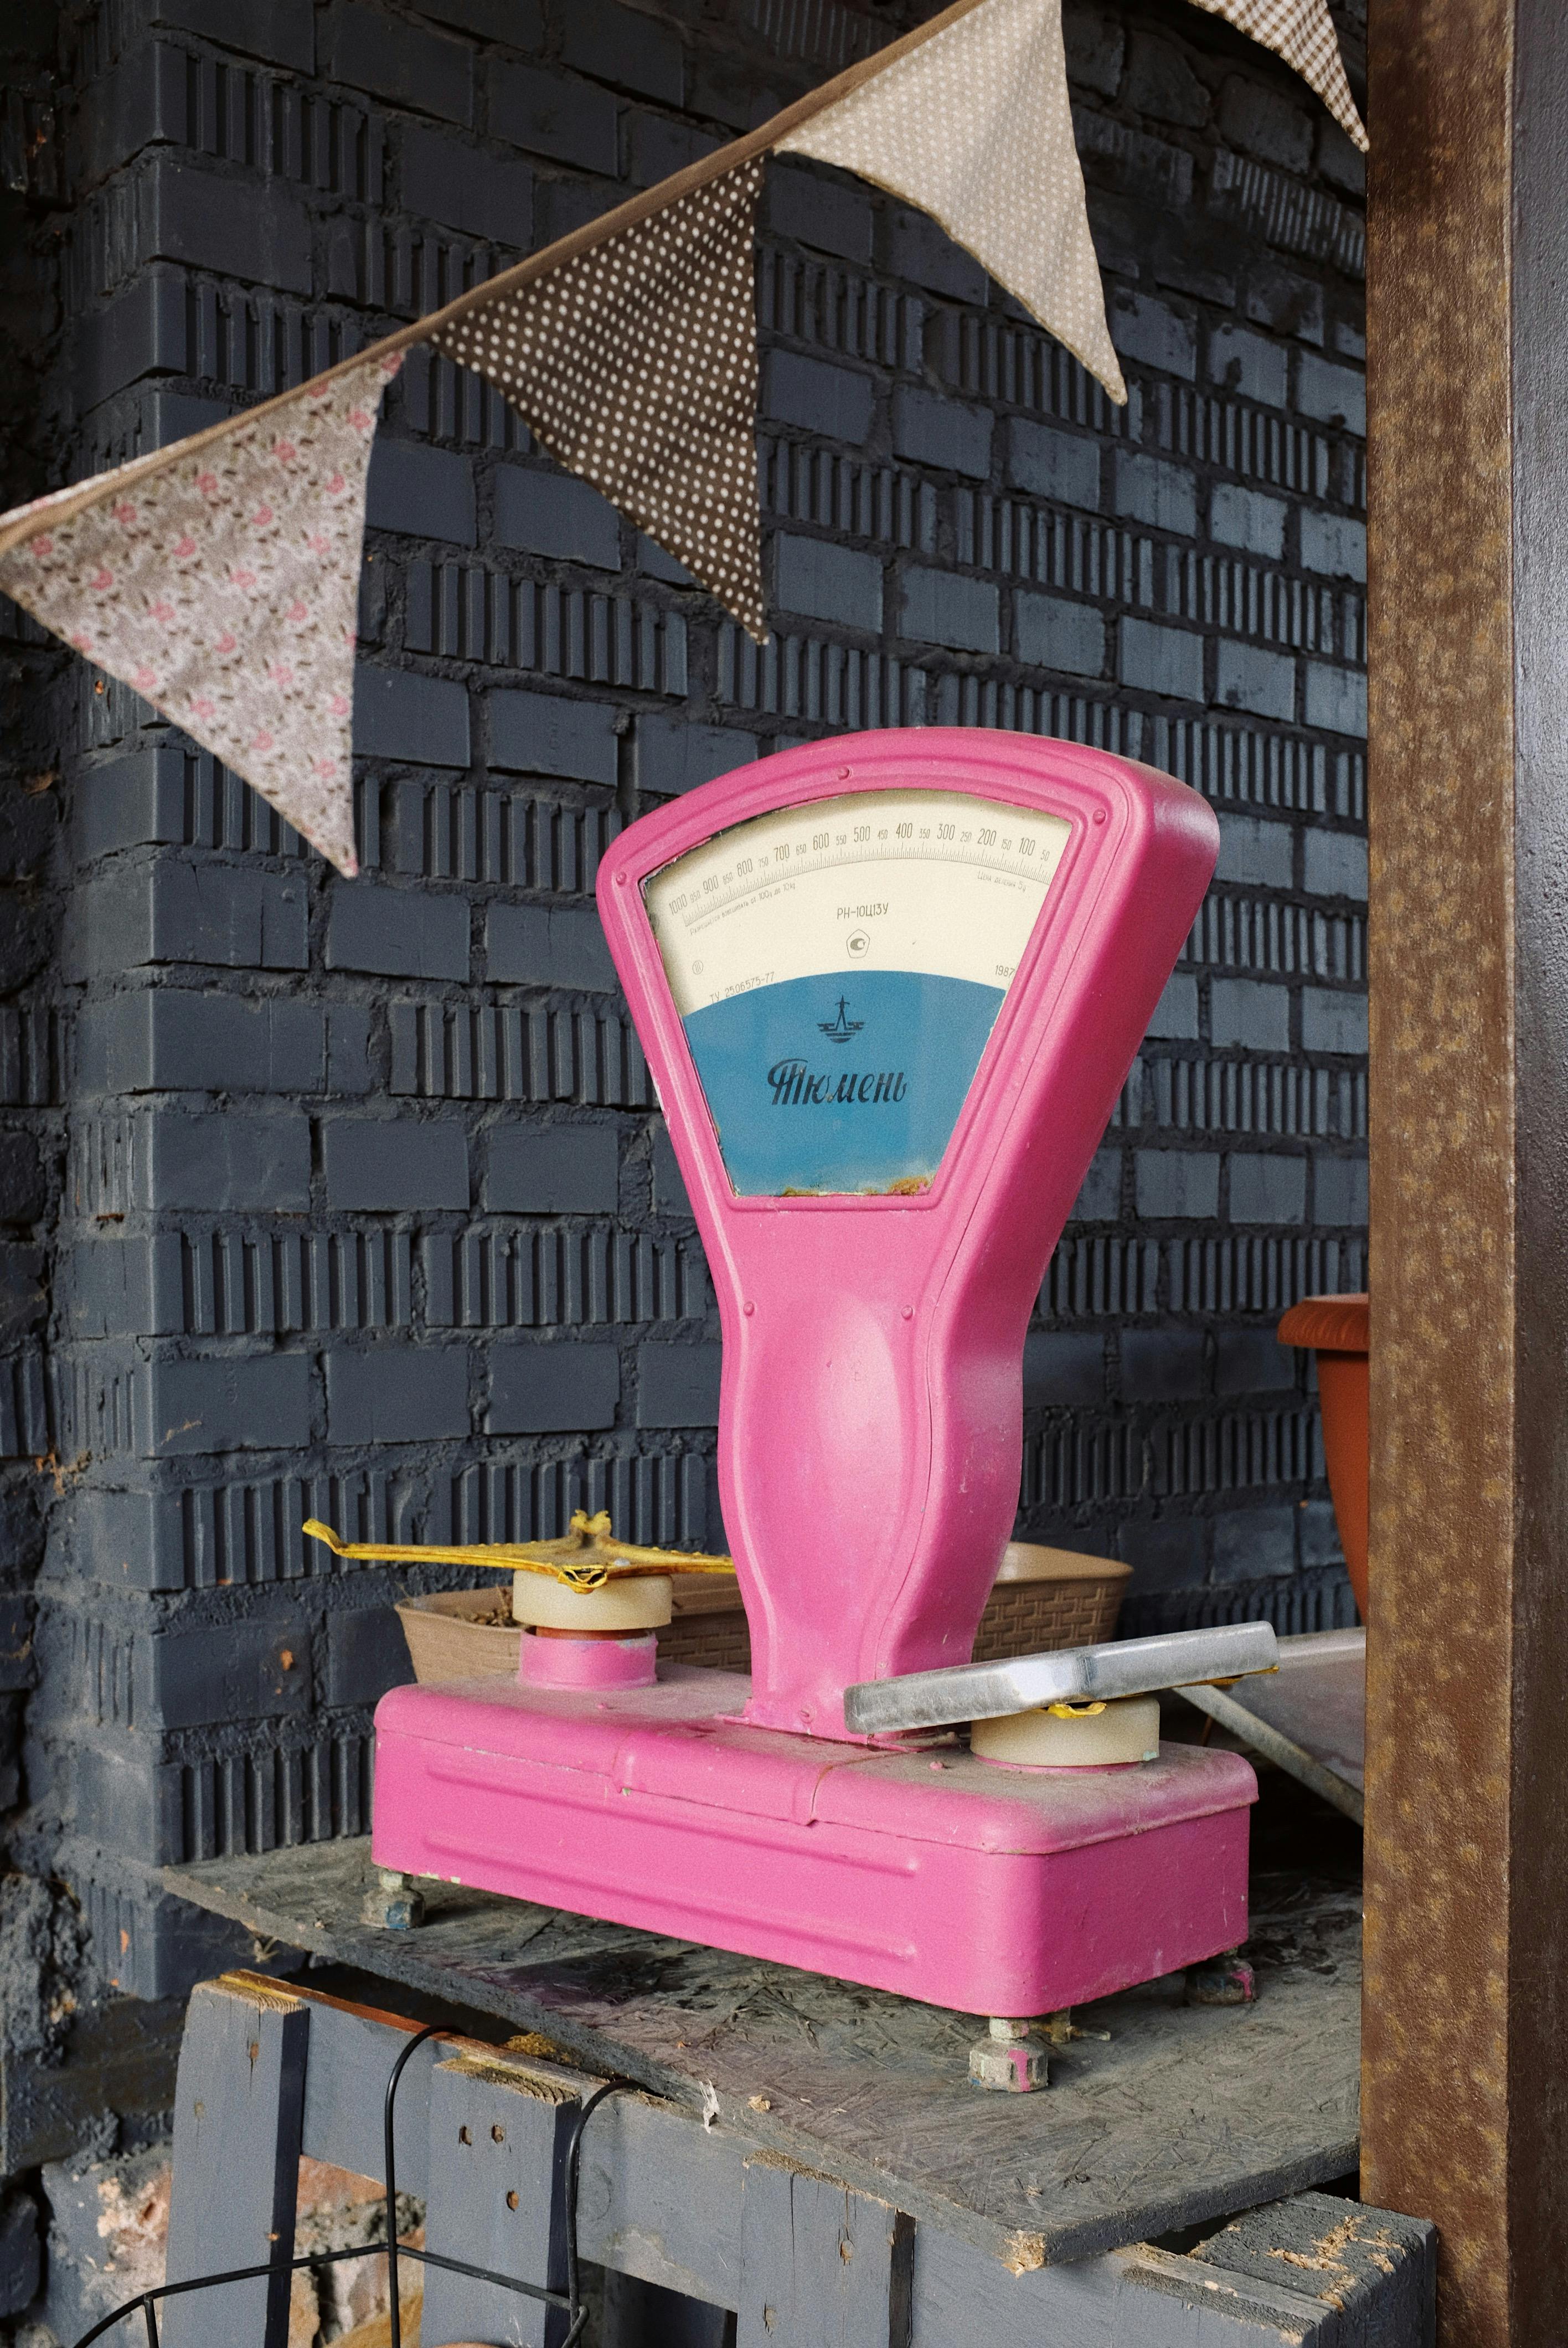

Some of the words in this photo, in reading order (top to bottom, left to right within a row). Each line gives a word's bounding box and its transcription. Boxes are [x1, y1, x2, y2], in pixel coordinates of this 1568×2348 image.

[668, 894, 688, 915] 1000
[690, 890, 701, 903] 950
[703, 875, 719, 894] 900
[723, 872, 733, 885] 850
[737, 858, 753, 877] 800
[758, 857, 768, 868] 750
[773, 843, 790, 862] 700
[796, 844, 807, 856] 650
[813, 832, 829, 851] 600
[836, 835, 847, 846] 550
[854, 826, 870, 843] 500
[877, 830, 888, 840] 450
[896, 822, 913, 839] 400
[919, 828, 930, 840] 350
[937, 823, 955, 841] 300
[960, 831, 972, 842] 250
[977, 828, 997, 846] 200
[1001, 838, 1012, 851] 150
[1019, 837, 1036, 856] 100
[1040, 849, 1050, 862] 50
[837, 902, 888, 919] РН-10Ц13У
[995, 965, 1015, 978] 1987
[767, 1058, 907, 1105] Тюмень
